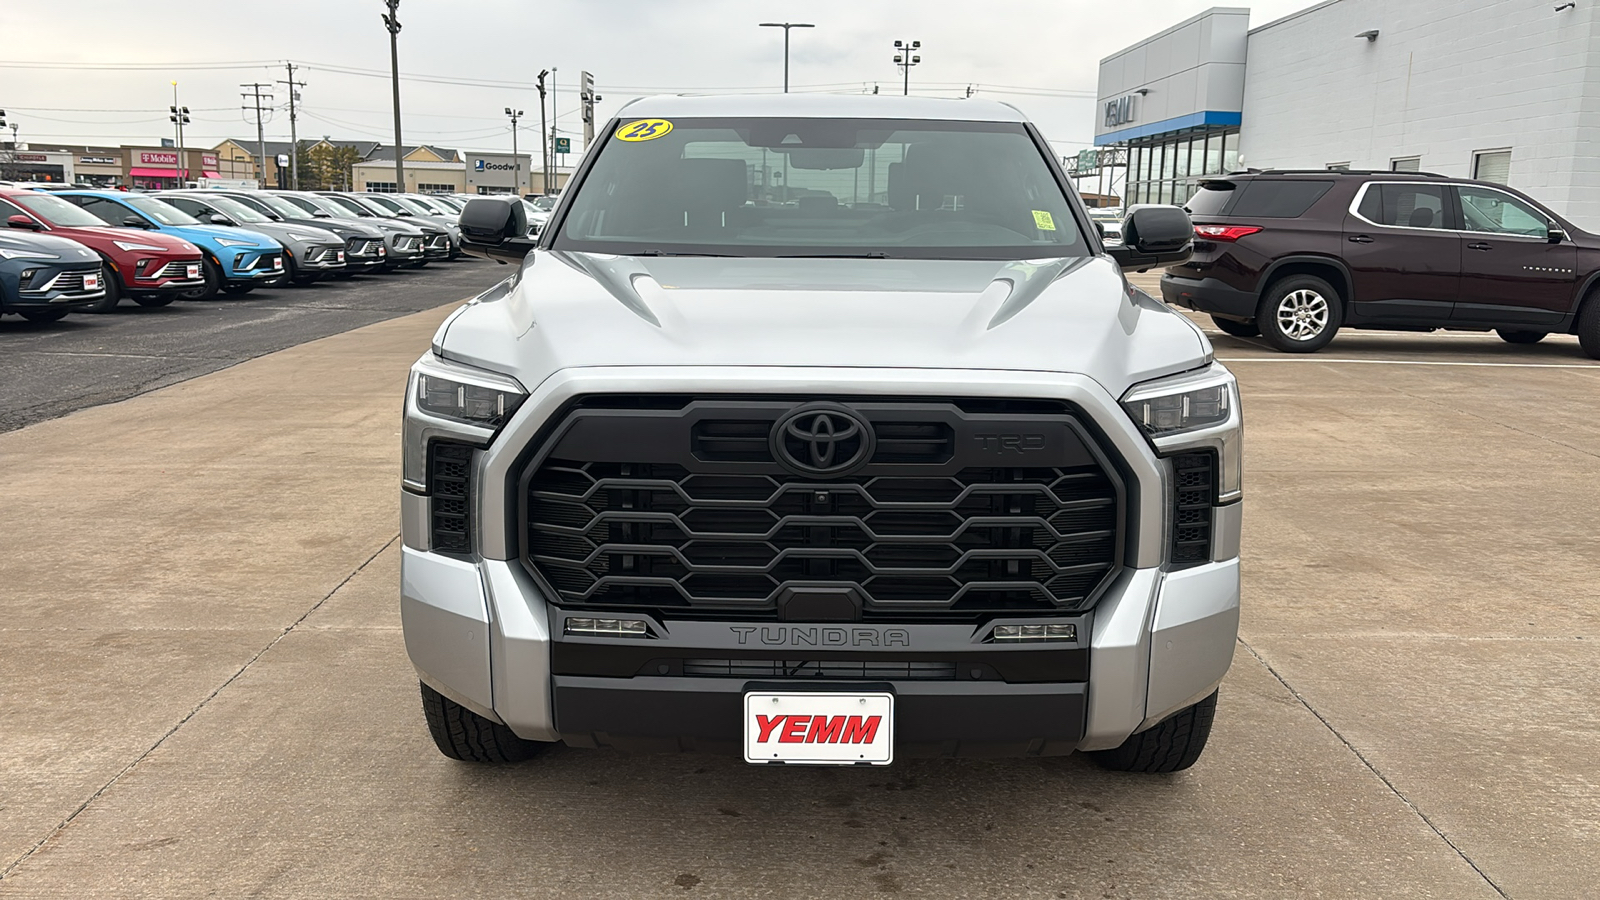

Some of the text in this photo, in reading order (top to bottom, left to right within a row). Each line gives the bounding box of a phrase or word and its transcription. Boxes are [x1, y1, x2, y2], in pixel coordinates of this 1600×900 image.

[625, 122, 664, 138] 25
[973, 433, 1046, 455] TRD
[729, 626, 910, 647] TUNDRA
[755, 714, 883, 745] YEMM
